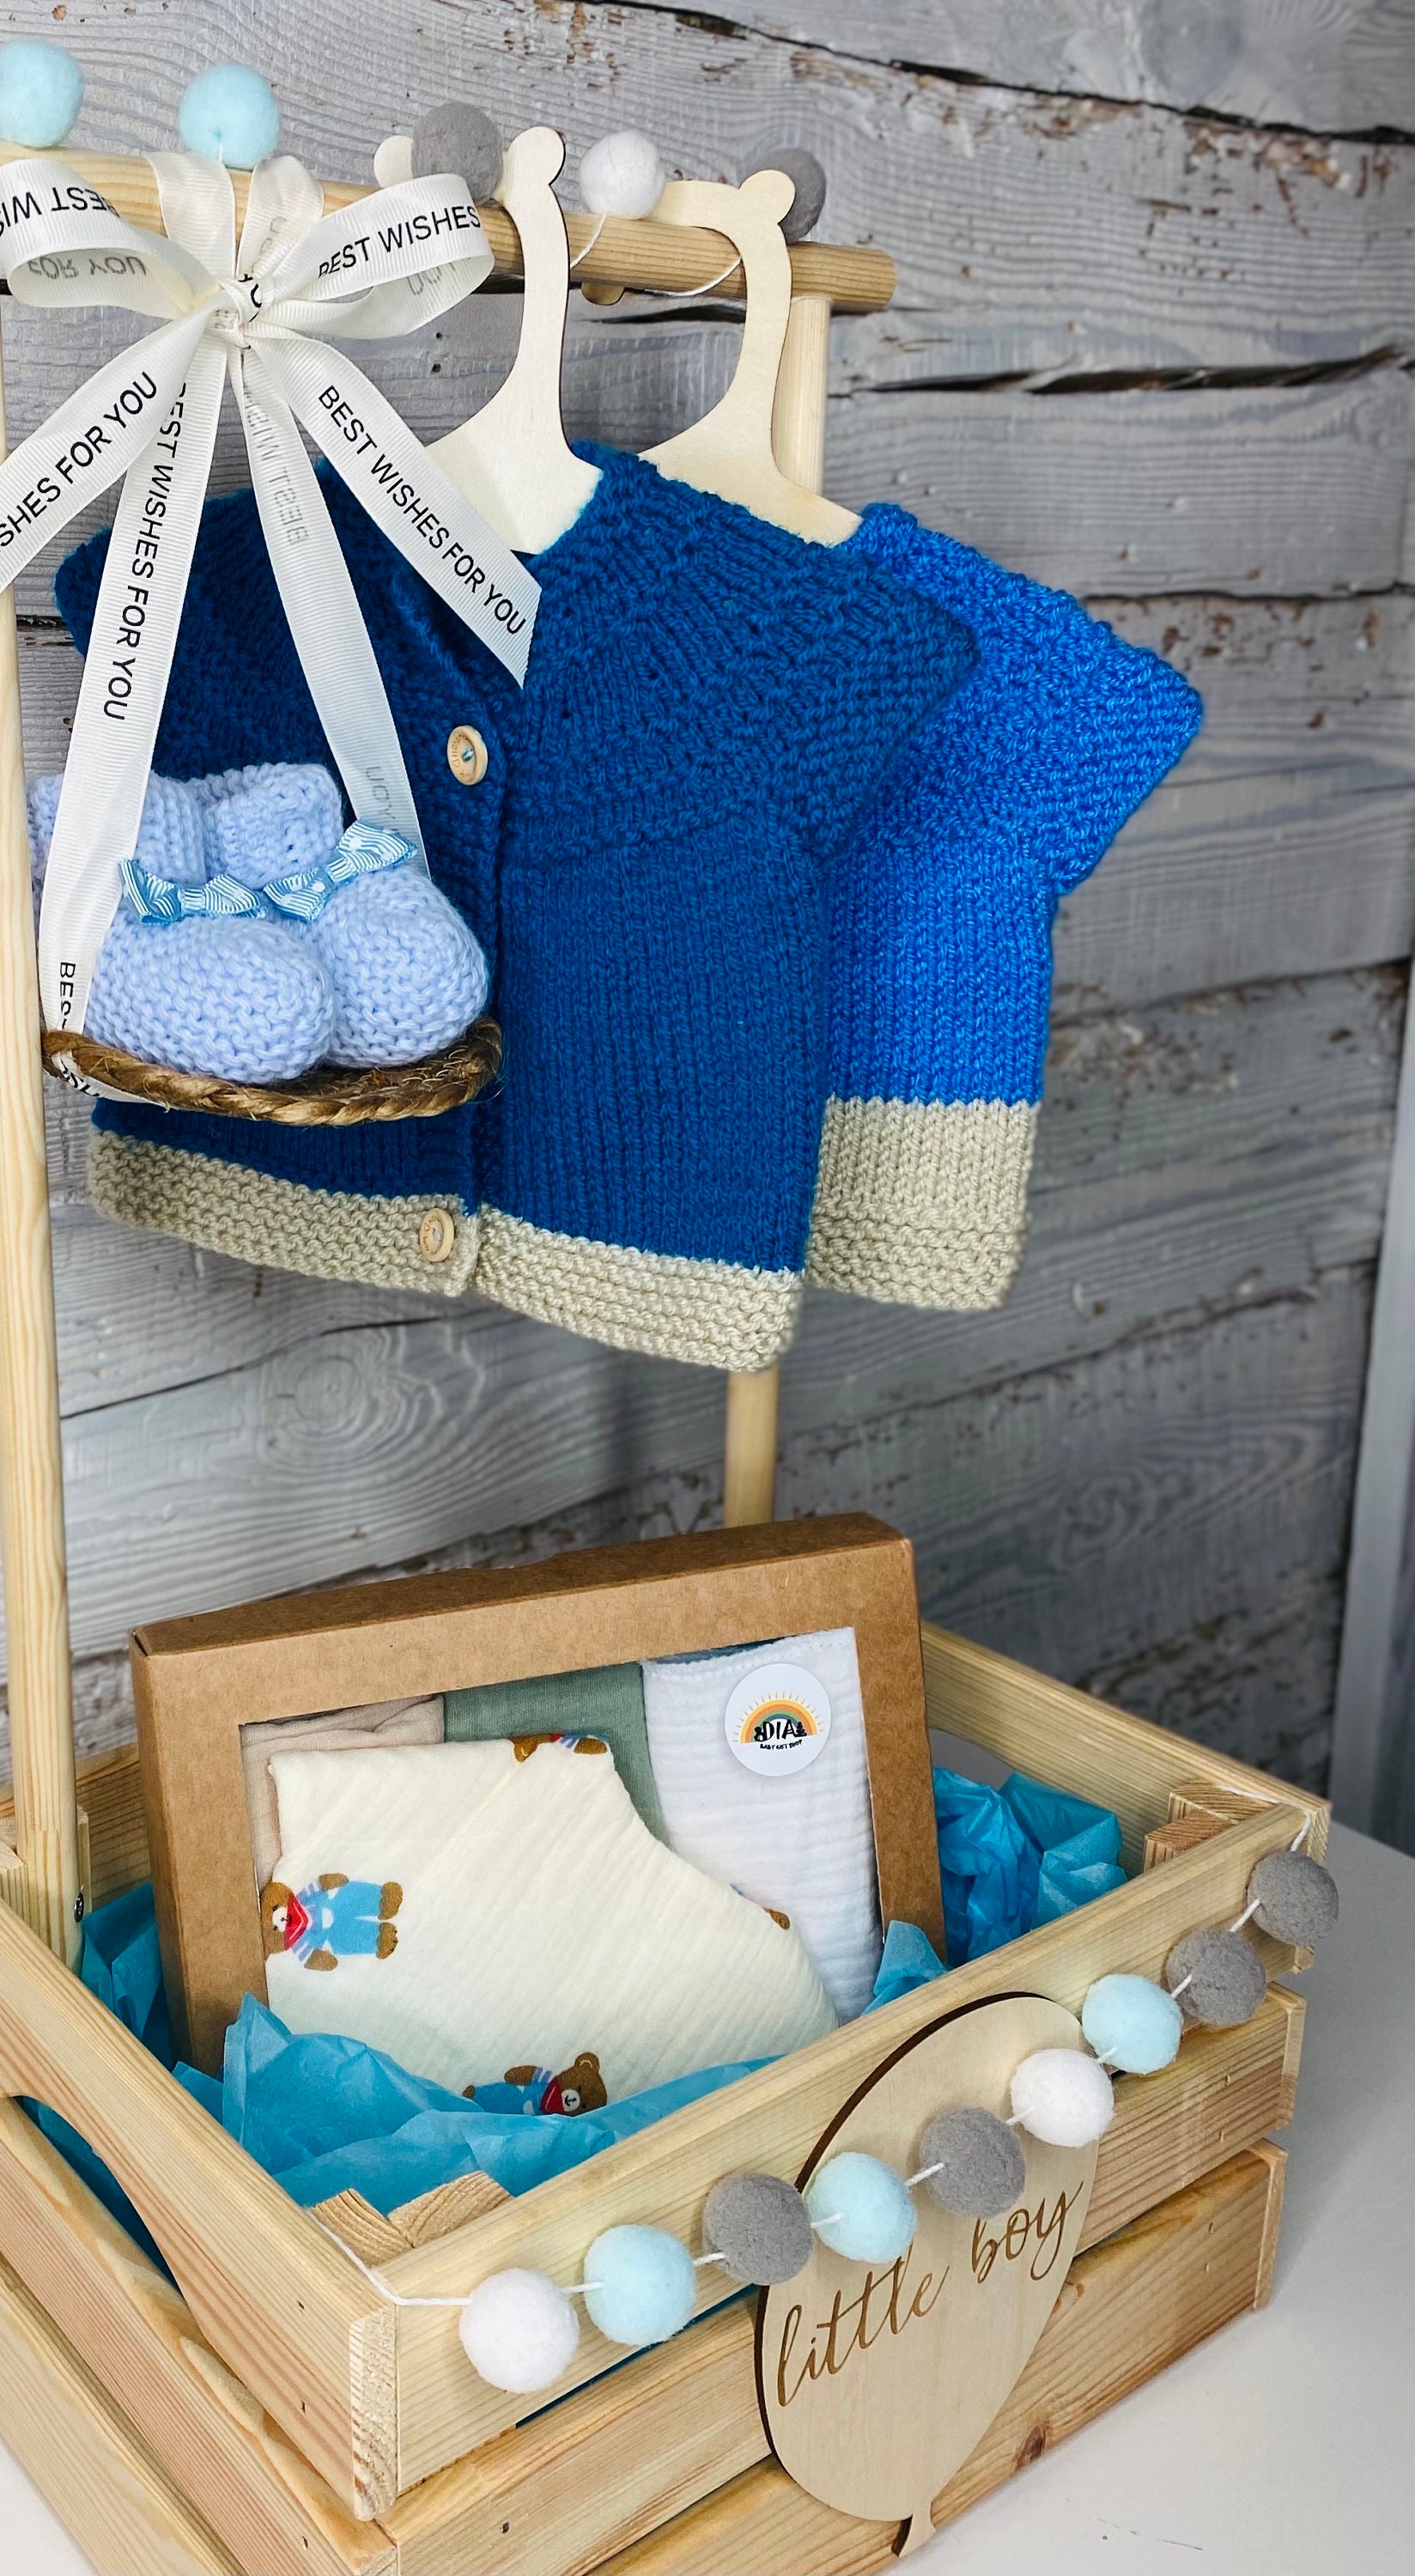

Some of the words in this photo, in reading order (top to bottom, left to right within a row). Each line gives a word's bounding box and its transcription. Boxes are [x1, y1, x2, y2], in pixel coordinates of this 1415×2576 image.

[378, 205, 481, 252] WISHES
[55, 425, 112, 484] FOR
[103, 371, 157, 428] YOU
[131, 465, 173, 579] WISHES
[319, 385, 377, 455] BEST
[371, 453, 449, 549] WISHES
[442, 542, 485, 593] FOR
[483, 584, 526, 635] YOU
[116, 585, 149, 648] FOR
[104, 658, 137, 720] YOU
[777, 2242, 950, 2407] little
[972, 2181, 1084, 2284] boy
